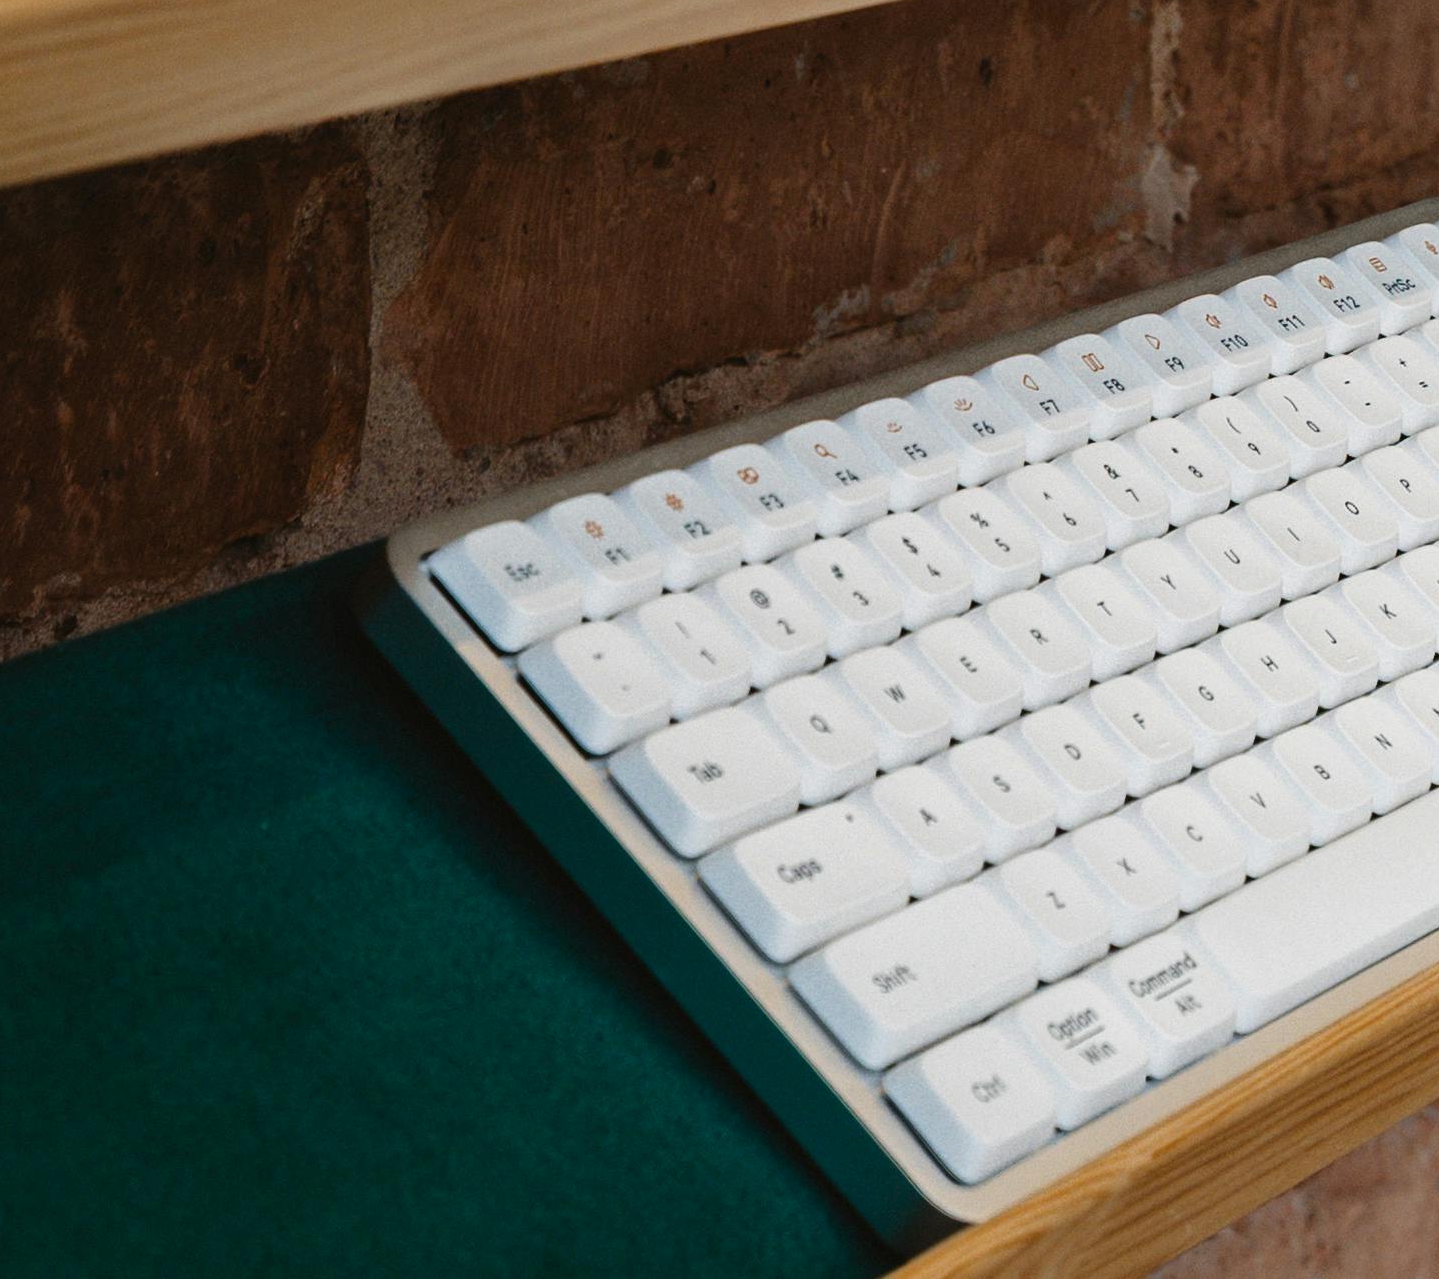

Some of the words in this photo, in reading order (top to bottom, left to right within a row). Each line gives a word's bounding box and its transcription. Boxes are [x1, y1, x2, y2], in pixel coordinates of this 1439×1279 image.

[1381, 278, 1417, 294] PrtSc
[1332, 295, 1361, 312] F12
[1277, 314, 1305, 331] F11
[1220, 333, 1249, 351] F10
[1164, 356, 1185, 371] F9
[1103, 378, 1126, 392] F8
[1039, 398, 1061, 415] F7
[972, 421, 996, 435] F6
[1305, 420, 1321, 434] 0
[903, 443, 928, 460] F5
[1247, 442, 1261, 455] 9
[835, 470, 860, 484] F4
[1187, 464, 1204, 479] 8
[1399, 478, 1411, 492] P
[759, 493, 785, 511] F3
[1125, 487, 1140, 502] 7
[1344, 500, 1360, 516] O
[1063, 513, 1078, 527] 6
[683, 520, 712, 538] F2
[994, 537, 1011, 553] 5
[604, 547, 629, 564] F1
[1224, 549, 1242, 565] U
[927, 565, 941, 577] 4
[1160, 574, 1176, 589] Y
[852, 590, 870, 607] 3
[1096, 600, 1111, 615] T
[1381, 604, 1396, 618] K
[776, 618, 795, 636] 2
[1029, 628, 1046, 642] R
[1325, 630, 1338, 645] J
[699, 648, 716, 664] 1
[959, 655, 978, 674] E
[1261, 656, 1278, 671] H
[886, 685, 906, 702] W
[1197, 685, 1215, 702] G
[809, 714, 832, 734] Q
[1132, 712, 1145, 728] F
[1374, 734, 1393, 749] N
[1063, 743, 1082, 761] D
[688, 763, 724, 782] Tab
[1313, 764, 1331, 781] B
[992, 775, 1011, 793] S
[1250, 792, 1267, 809] V
[919, 809, 936, 824] A
[1185, 824, 1204, 843] C
[777, 859, 823, 884] Caps
[1117, 858, 1136, 875] X
[1046, 890, 1066, 910] Z
[872, 965, 915, 994] Shift
[1128, 952, 1198, 1001] Command
[1176, 996, 1202, 1014] Alt
[1047, 1008, 1102, 1039] Option
[1078, 1037, 1117, 1064] Win
[971, 1075, 1006, 1103] Ctrl
